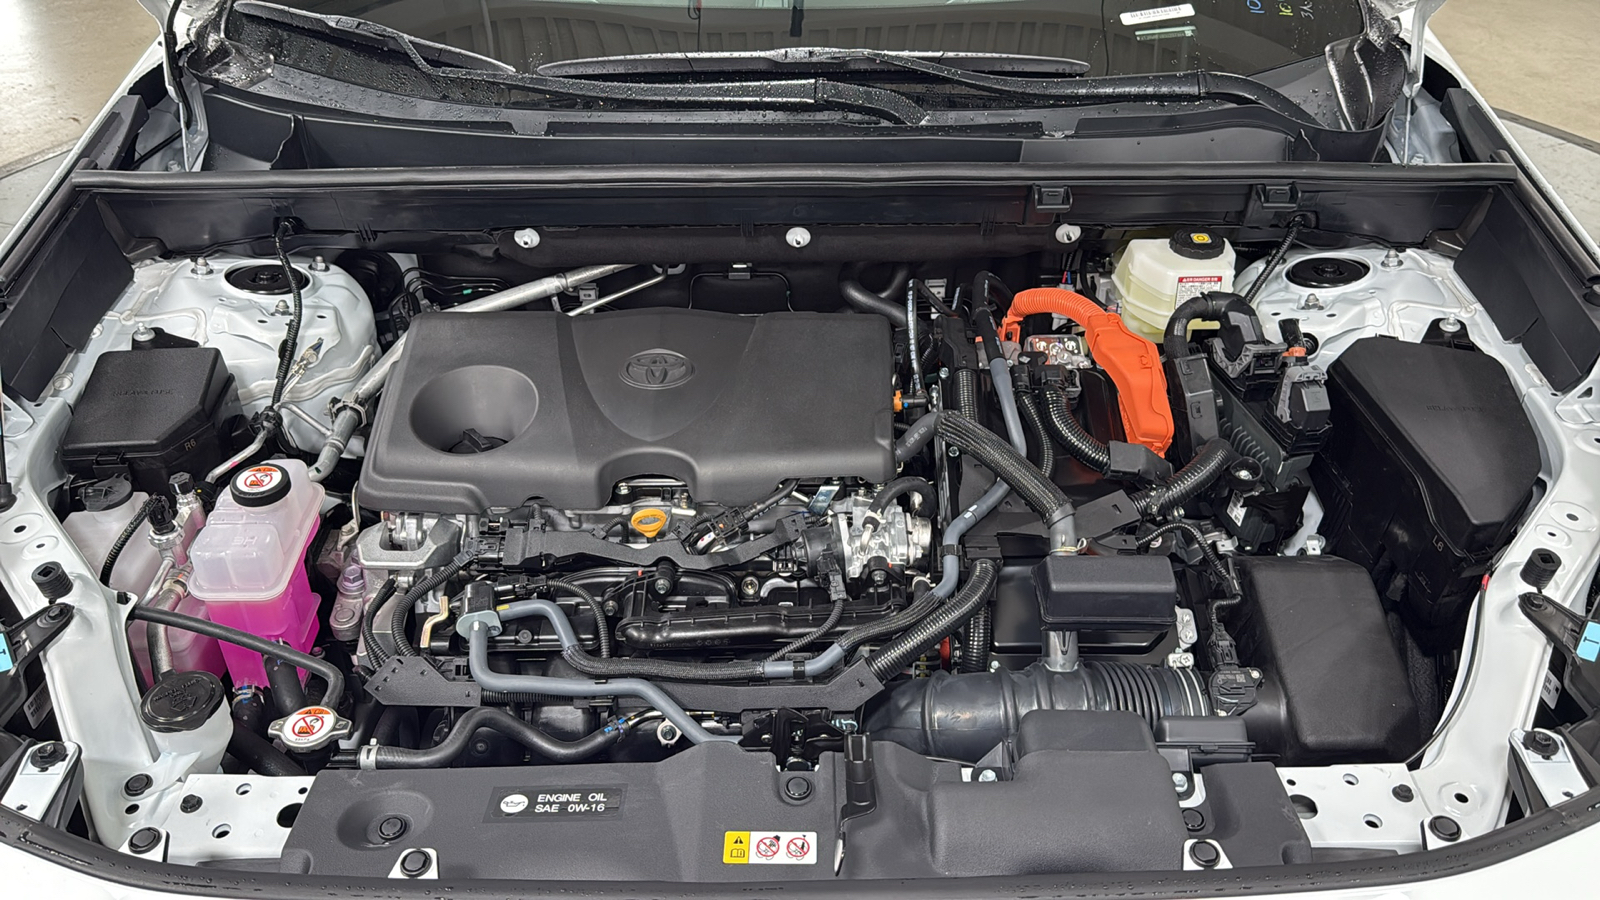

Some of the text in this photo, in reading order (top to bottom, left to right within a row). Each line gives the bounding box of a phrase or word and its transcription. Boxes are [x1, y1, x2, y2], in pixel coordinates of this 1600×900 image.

[537, 793, 607, 802] ENGINE OIL
[534, 803, 605, 813] SAE 0W-16
